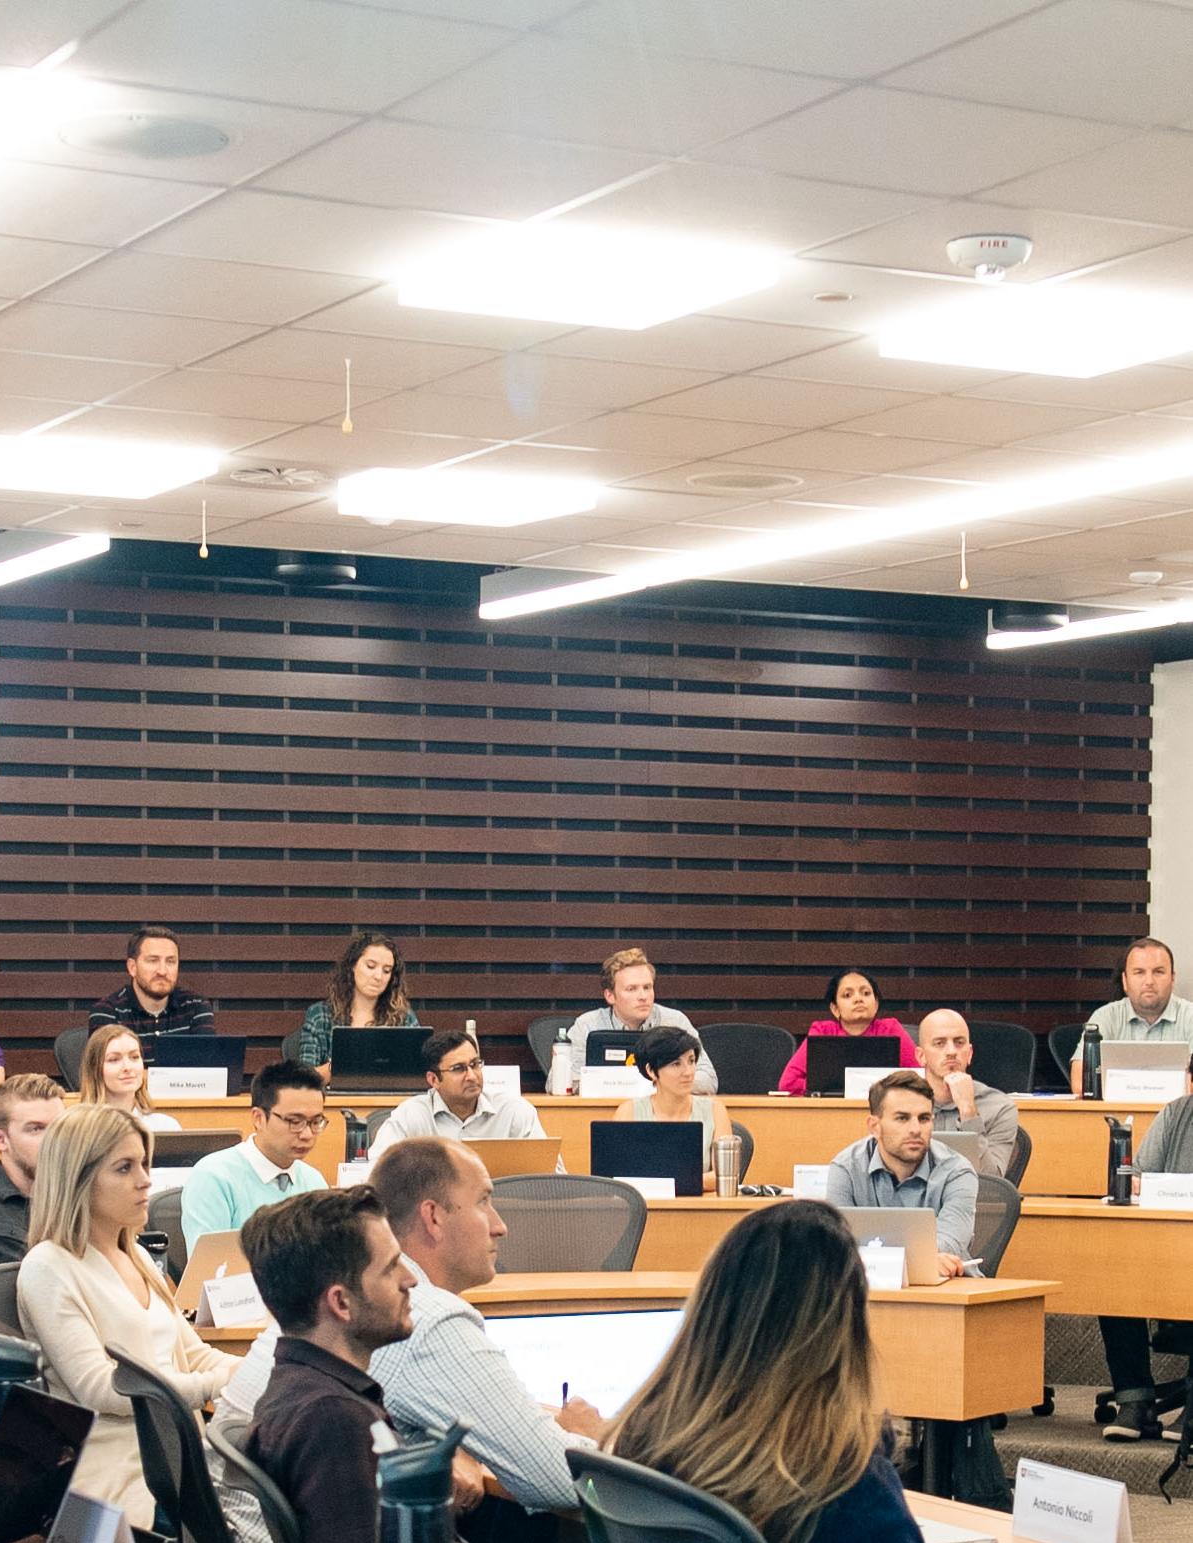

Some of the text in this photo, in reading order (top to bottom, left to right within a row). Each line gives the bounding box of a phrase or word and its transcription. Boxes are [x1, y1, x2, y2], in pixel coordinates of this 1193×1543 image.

[980, 239, 1008, 248] FIRE
[1033, 1497, 1093, 1523] Antonio Niccoli
